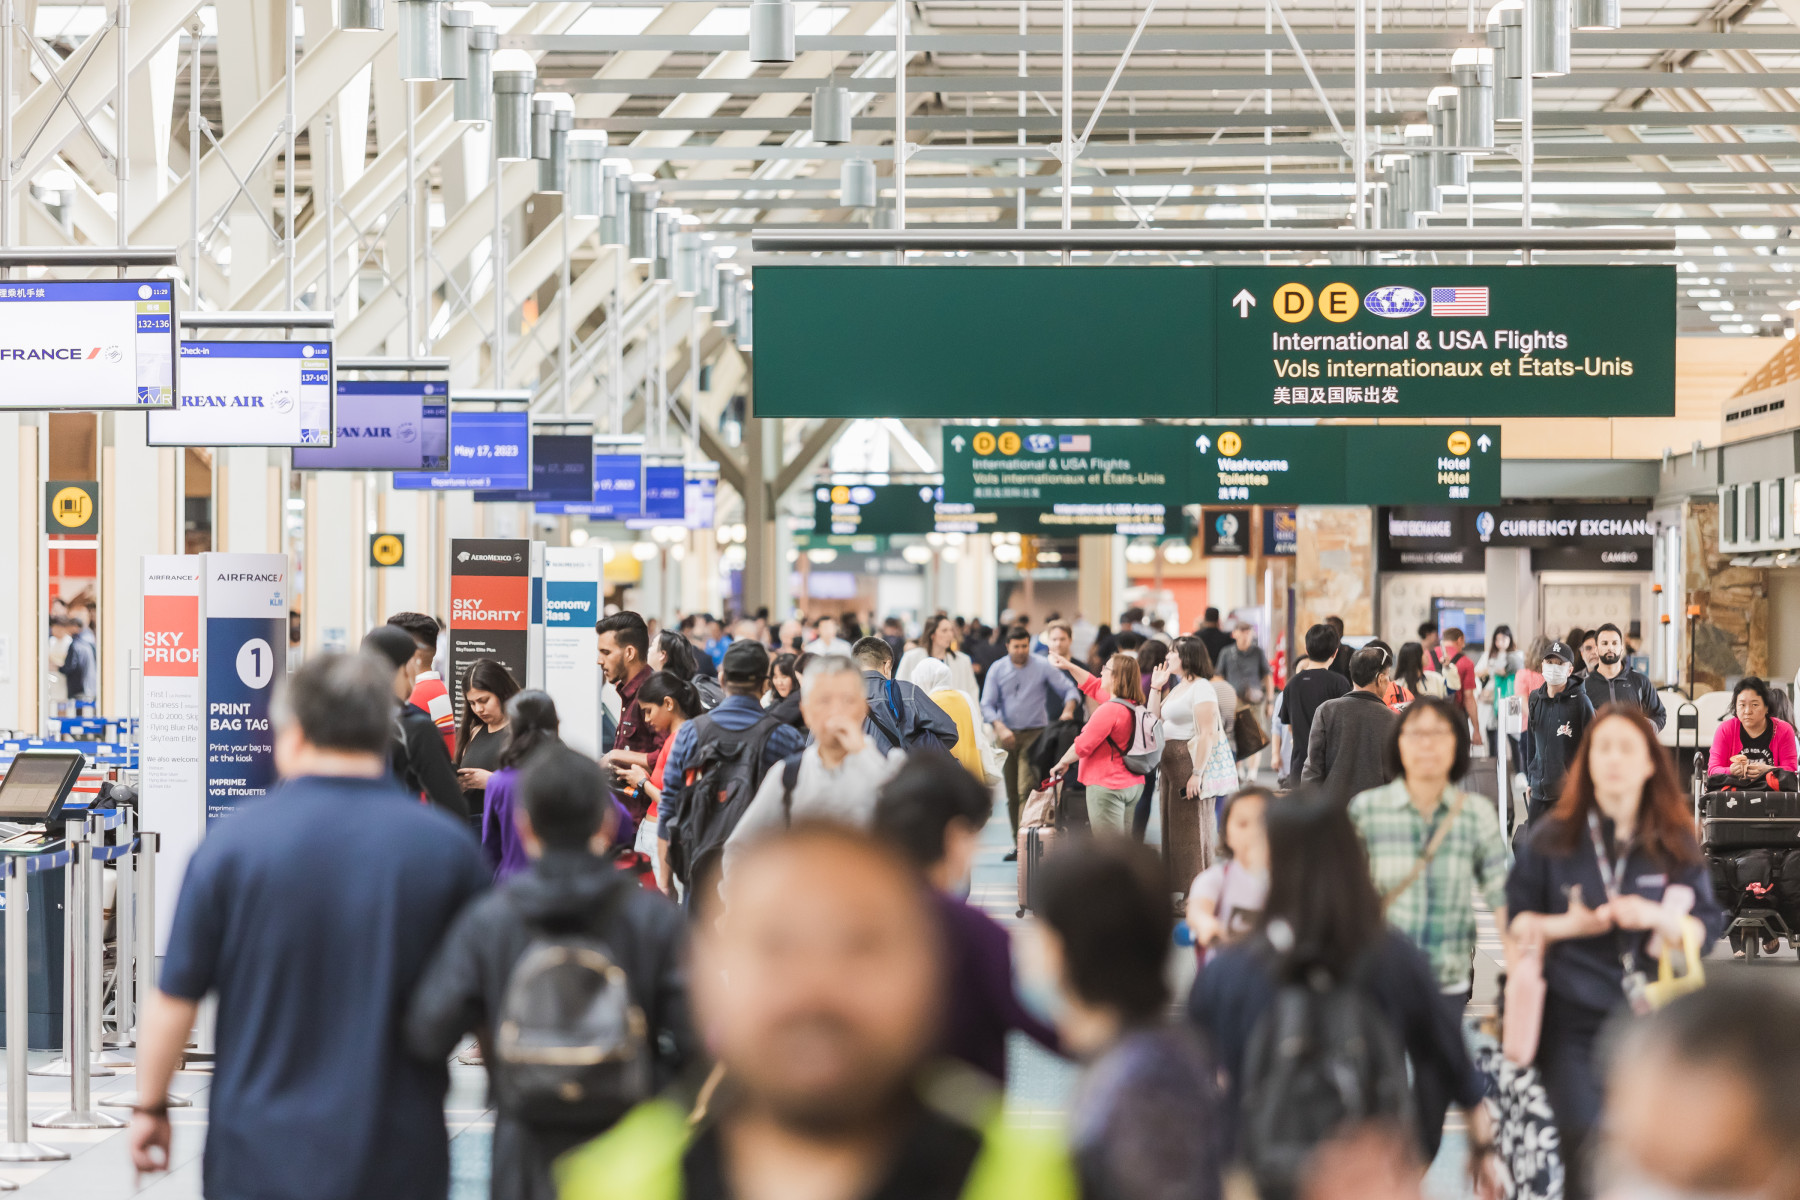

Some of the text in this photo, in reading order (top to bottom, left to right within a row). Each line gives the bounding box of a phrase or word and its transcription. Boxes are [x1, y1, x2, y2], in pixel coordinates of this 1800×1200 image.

[138, 320, 170, 328] 132-136
[1272, 330, 1568, 353] International & USA Flights
[0, 348, 82, 360] FRANCE
[180, 347, 210, 355] Check-in
[1273, 353, 1634, 378] Vols internationaux et États-Unis
[137, 393, 173, 404] YVR
[1273, 386, 1399, 404] 美国及国际出发
[231, 396, 264, 407] AIR
[362, 427, 391, 438] AIR
[454, 445, 475, 458] May
[973, 458, 1130, 472] International & USA Flights
[1217, 458, 1288, 471] Washrooms
[1437, 457, 1470, 470] Hotel
[973, 470, 1166, 484] Vols internationaux et États-Unis
[1217, 472, 1269, 486] Toilettes
[1437, 471, 1470, 484] Hôtel
[1499, 519, 1578, 536] CURRENCY
[1601, 552, 1639, 563] CAMBIO
[217, 573, 278, 582] AIRFRANCE
[453, 598, 483, 609] SKY
[545, 599, 591, 612] conomy
[452, 610, 521, 621] PRIORITY
[144, 631, 184, 646] SKY
[250, 647, 261, 678] 1
[210, 703, 251, 715] PRINT
[210, 719, 269, 731] BAG TAG
[209, 743, 272, 754] Print your bag tag
[220, 754, 234, 762] the
[235, 754, 253, 762] kiosk
[209, 787, 266, 796] VOS ÉTIQUETTES
